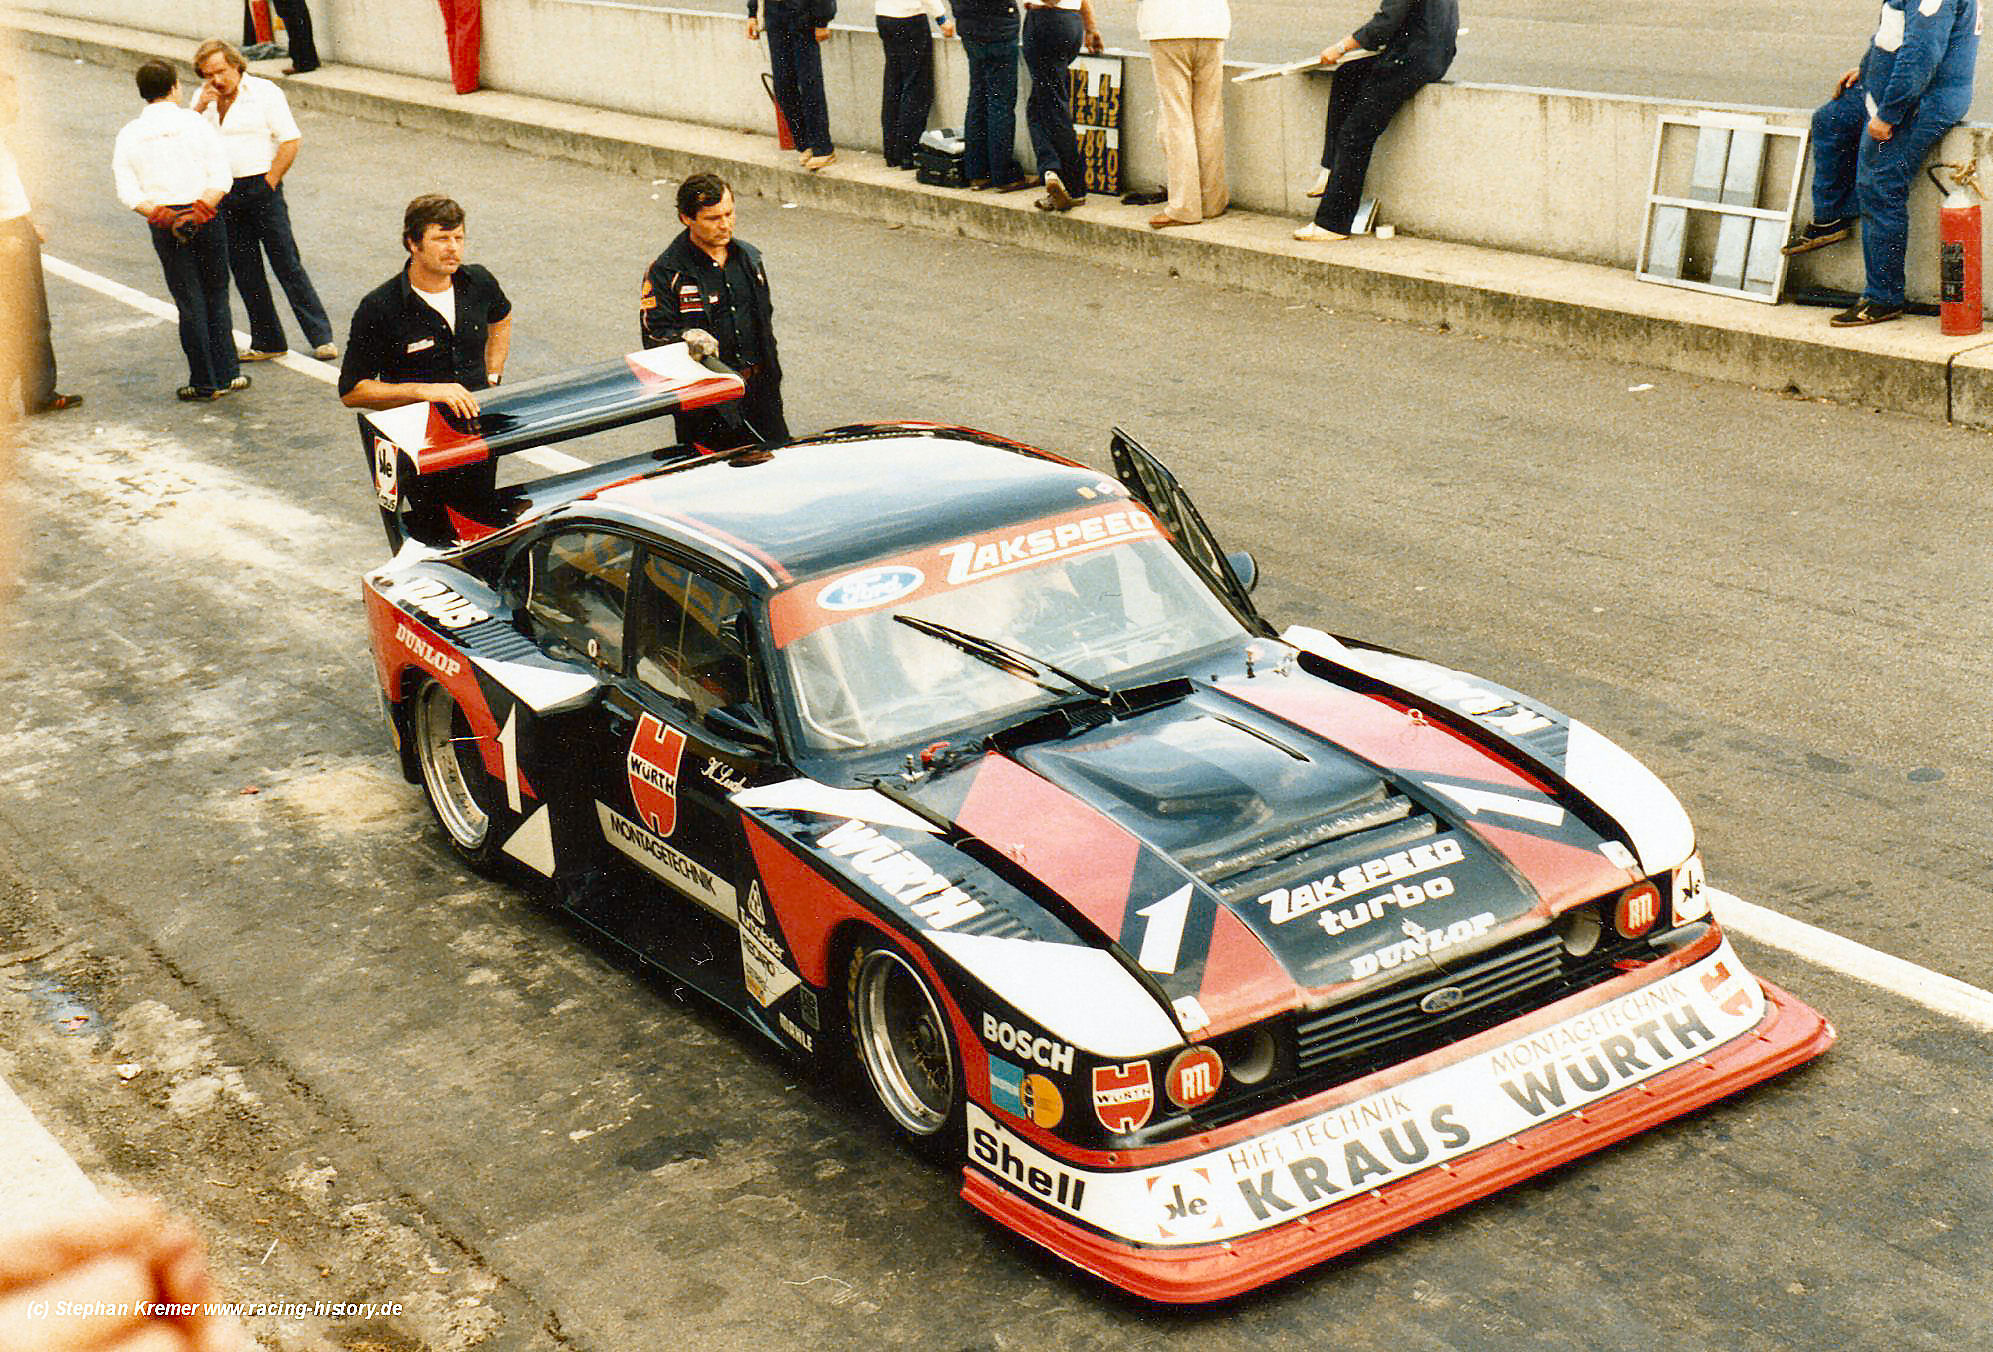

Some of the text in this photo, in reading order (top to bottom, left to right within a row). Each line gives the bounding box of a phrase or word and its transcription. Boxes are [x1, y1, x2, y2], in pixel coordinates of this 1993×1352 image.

[938, 511, 1158, 585] ZAKSPEED
[395, 622, 461, 677] DUNLOP
[629, 755, 675, 797] WÜRTH
[610, 813, 717, 897] MONTAGETECHNIK
[1258, 838, 1466, 925] ZAKSPEED
[1317, 876, 1456, 936] turbo
[1350, 911, 1498, 980] DUNLOP
[982, 1010, 1075, 1076] BOSCH
[1500, 1004, 1716, 1117] WÜRTH
[1290, 1095, 1411, 1151] TECHNIK
[973, 1126, 1086, 1212] Shell
[1237, 1104, 1472, 1222] KRAUS
